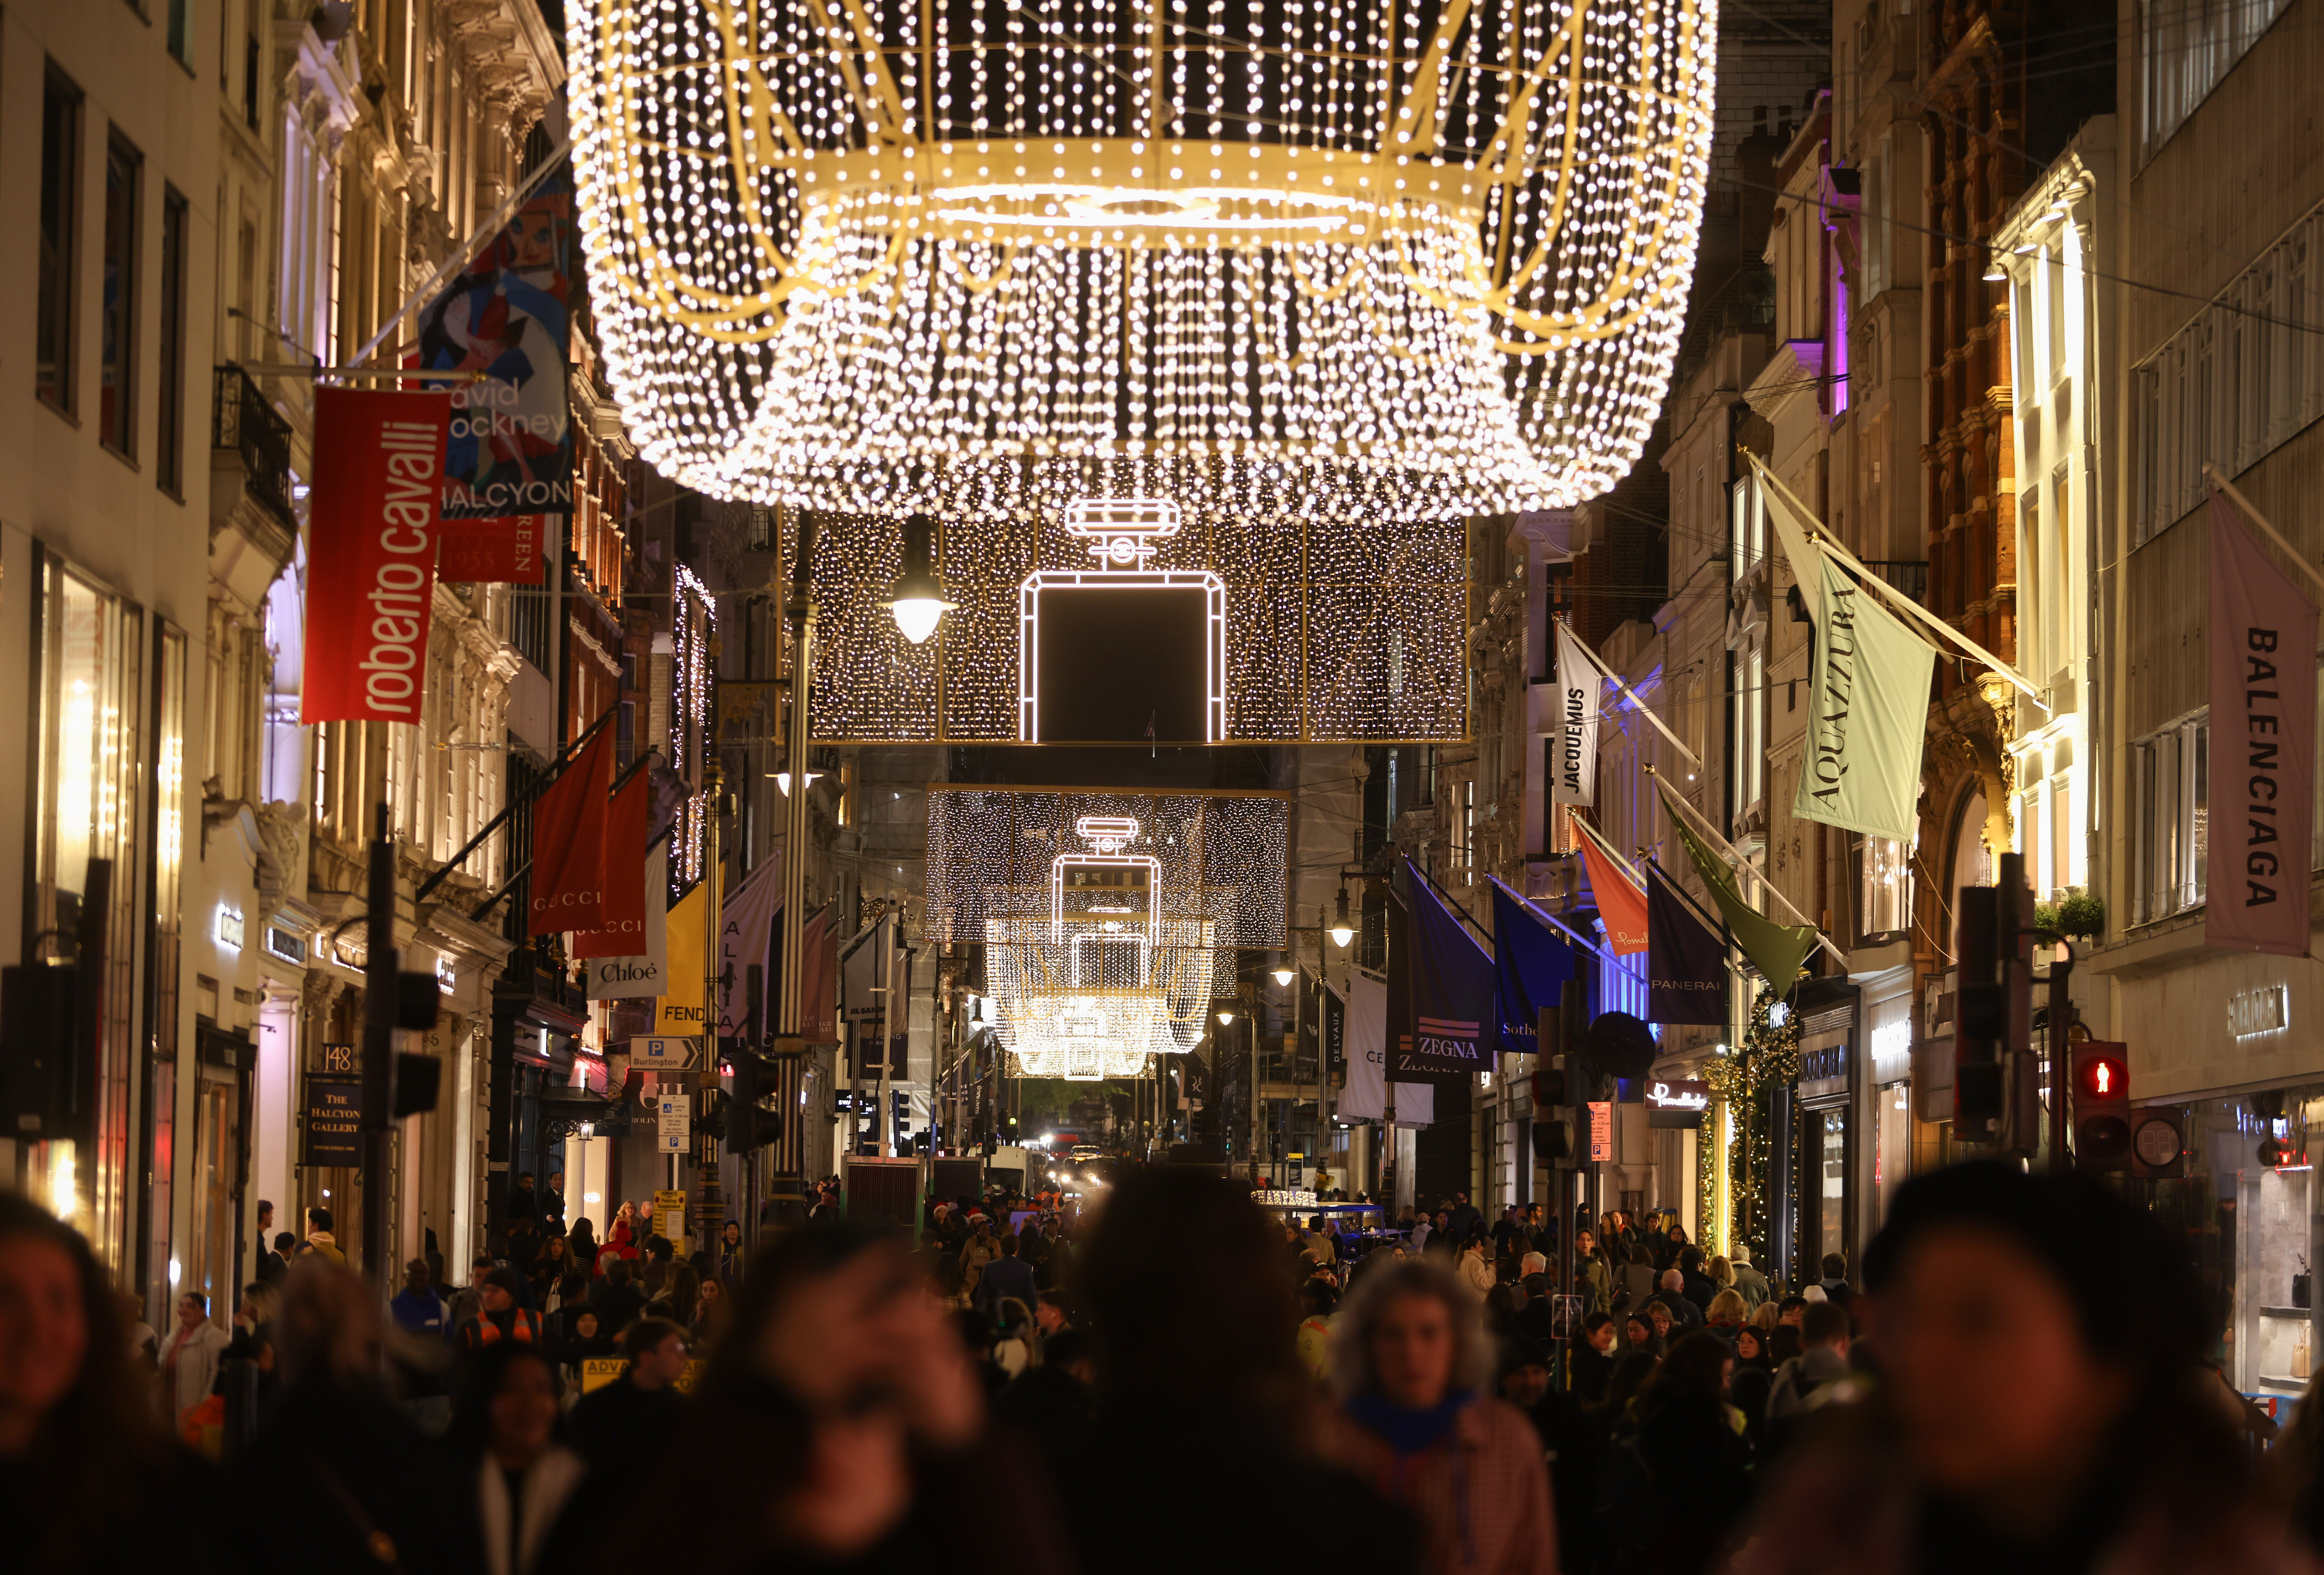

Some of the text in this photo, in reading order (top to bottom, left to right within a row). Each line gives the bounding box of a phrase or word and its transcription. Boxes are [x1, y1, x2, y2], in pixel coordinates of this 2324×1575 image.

[450, 408, 566, 445] ockney
[515, 515, 533, 572] REEN
[360, 422, 438, 713] roberto cavalli
[1812, 587, 1855, 813] AQUAZZURA
[1565, 687, 1584, 794] JACQUEMUS
[2246, 627, 2278, 907] BALENCIAGA
[1615, 931, 1649, 946] Pomel
[601, 962, 657, 982] Chloé
[1652, 980, 1720, 990] PANERAI
[665, 1006, 704, 1021] FEND
[1503, 1023, 1539, 1036] Sothe
[652, 1043, 662, 1054] P
[1419, 1037, 1479, 1058] ZEGNA
[326, 1047, 351, 1070] 148
[634, 1058, 678, 1067] Burlington
[326, 1094, 347, 1104] THE
[1646, 1082, 1707, 1107] Pomellato
[312, 1108, 360, 1118] HALCYON
[312, 1122, 359, 1132] GALLERY
[1594, 1146, 1600, 1154] P
[588, 1361, 629, 1372] ADVA
